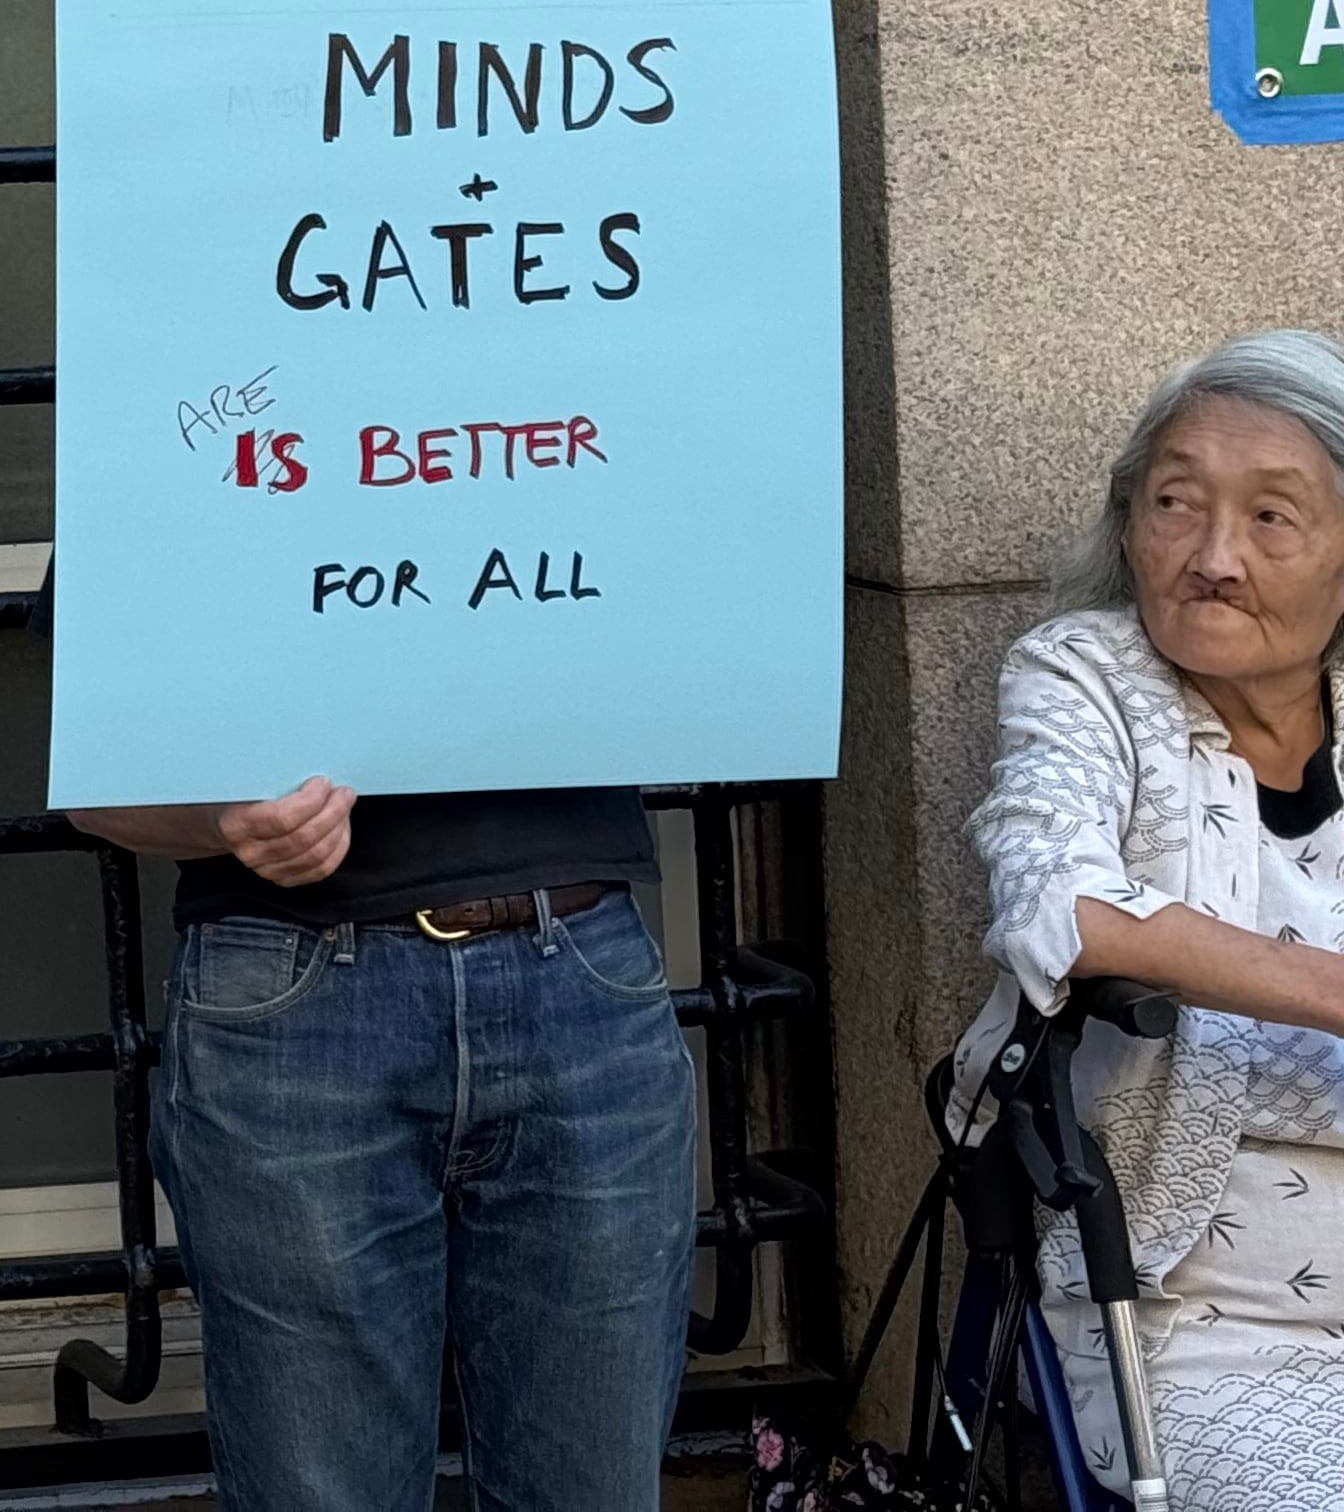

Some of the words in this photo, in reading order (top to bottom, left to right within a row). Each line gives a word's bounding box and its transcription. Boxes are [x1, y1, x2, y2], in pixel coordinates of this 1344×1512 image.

[322, 33, 678, 142] MINDS
[275, 213, 641, 312] GATES
[176, 365, 279, 452] ARE
[234, 429, 308, 493] IS
[359, 415, 608, 487] BETTER
[312, 559, 431, 614] FOR
[468, 548, 602, 610] ALL
